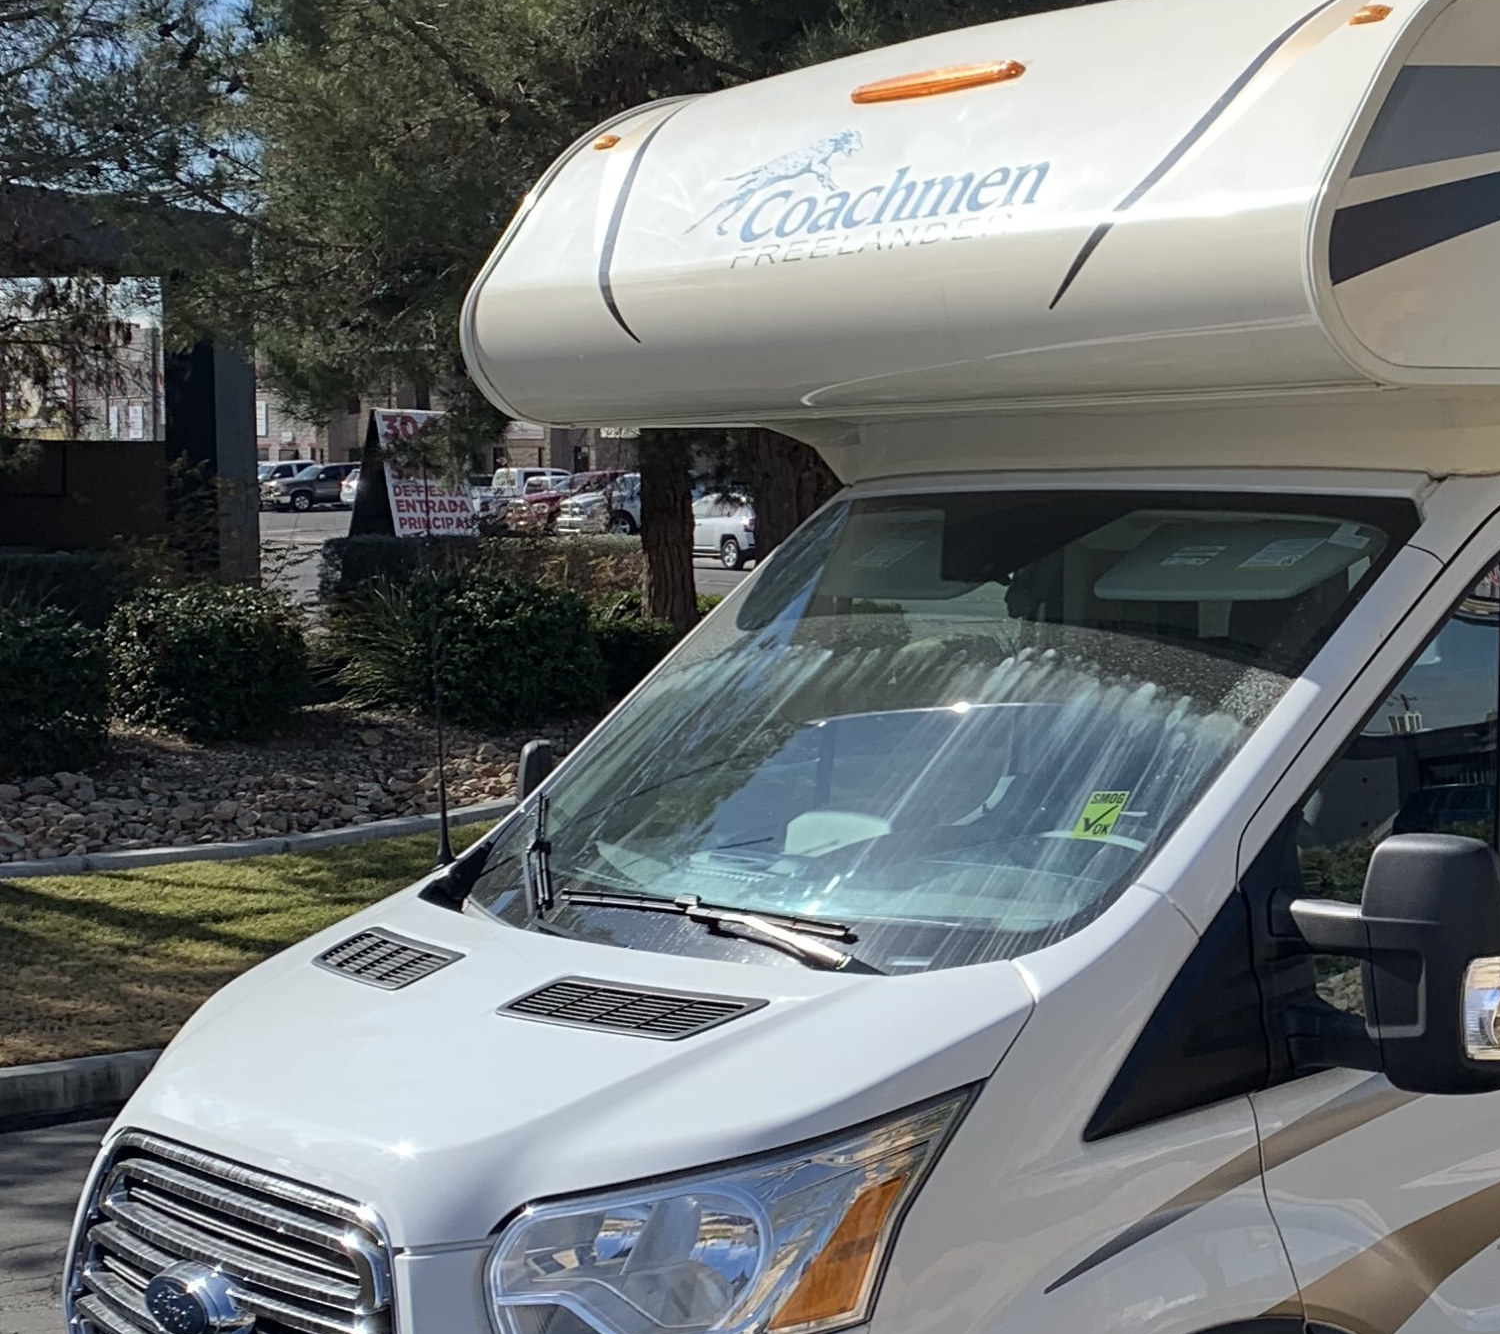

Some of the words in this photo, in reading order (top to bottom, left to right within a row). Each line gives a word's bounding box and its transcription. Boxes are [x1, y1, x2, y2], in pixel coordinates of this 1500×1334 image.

[740, 161, 1051, 243] Coachmen
[395, 499, 470, 513] ENTRADA
[1090, 793, 1126, 805] SMOG
[1092, 823, 1112, 835] OK
